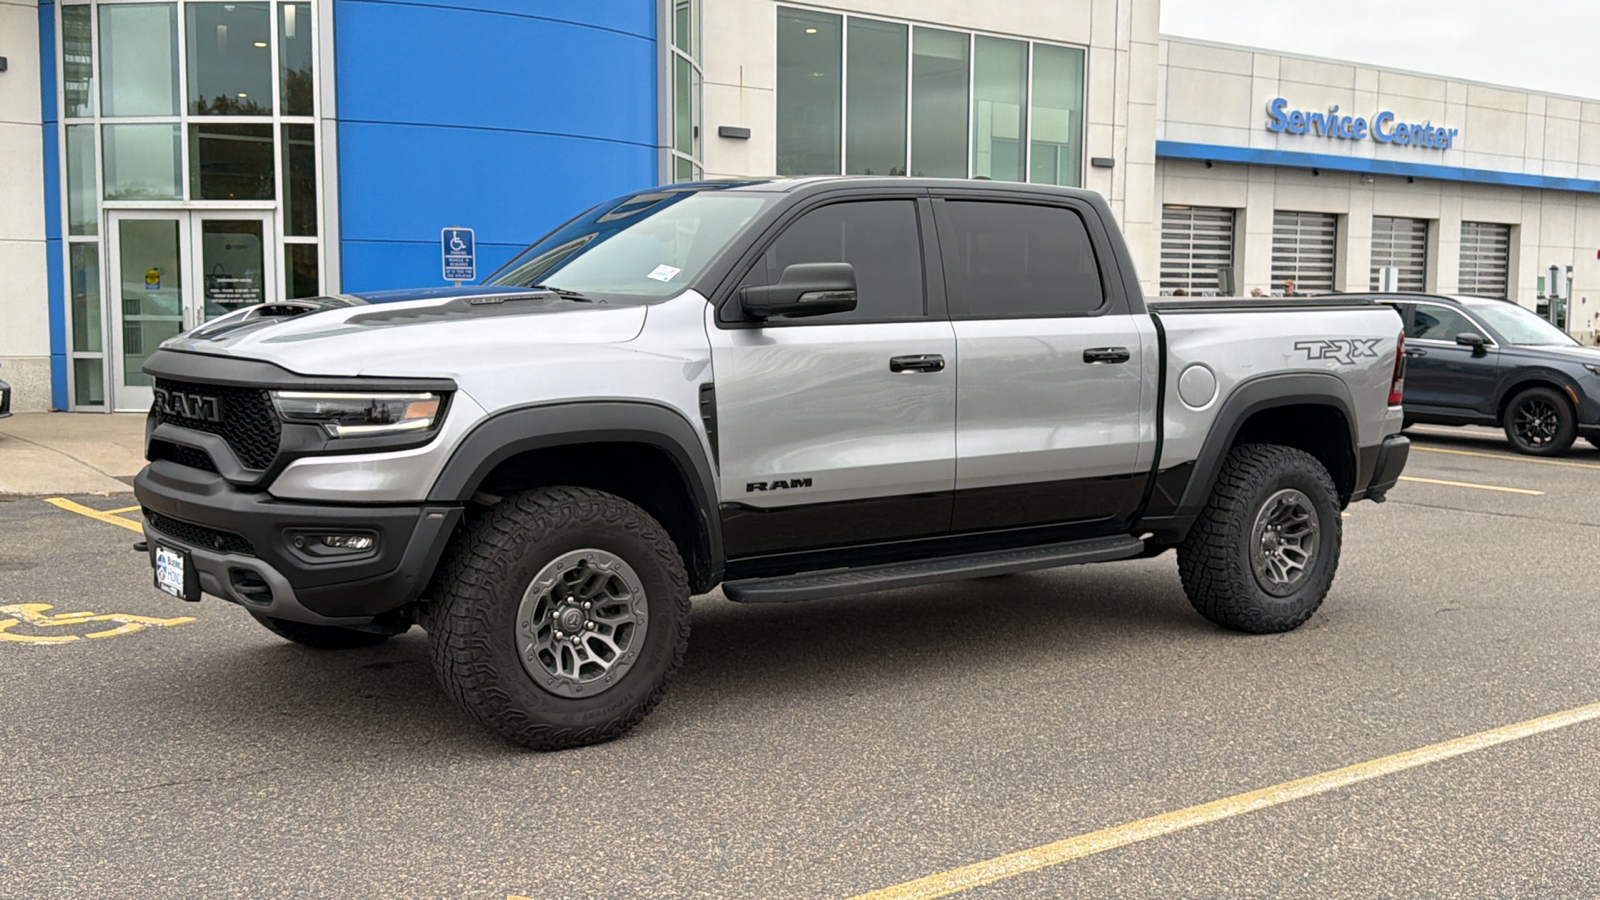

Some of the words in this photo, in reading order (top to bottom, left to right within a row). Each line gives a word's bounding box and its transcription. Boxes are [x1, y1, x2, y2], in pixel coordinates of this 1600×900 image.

[1265, 97, 1367, 140] Service
[1370, 110, 1458, 150] Center
[1294, 338, 1384, 365] TRX
[155, 387, 220, 421] RAM
[746, 478, 813, 492] RAM
